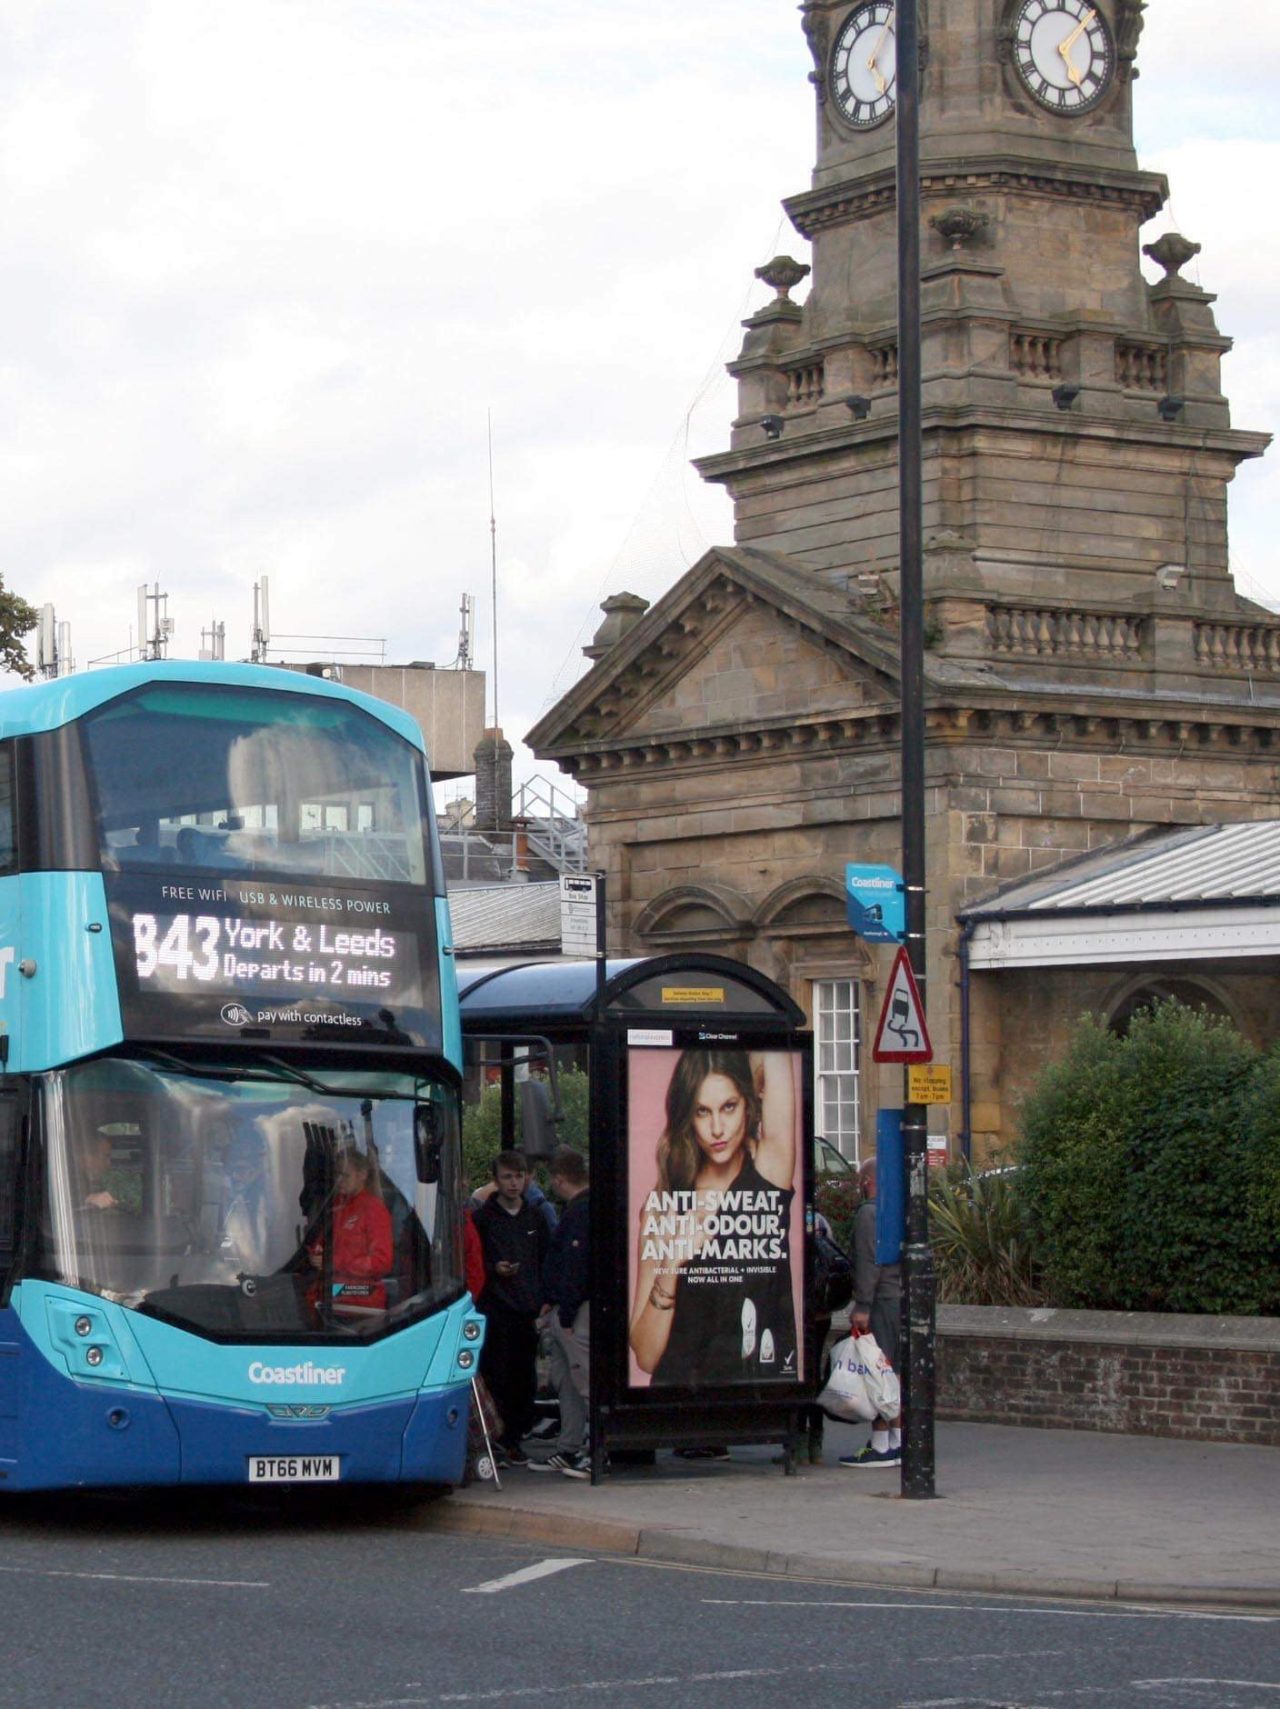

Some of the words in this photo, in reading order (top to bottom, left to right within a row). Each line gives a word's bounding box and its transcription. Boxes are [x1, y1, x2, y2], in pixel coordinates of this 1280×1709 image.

[851, 876, 895, 889] Coastliner
[161, 885, 195, 901] FREE
[198, 887, 228, 902] WIFI
[239, 891, 265, 905] USB
[268, 893, 278, 906] &
[282, 894, 343, 912] WIRELESS
[347, 899, 391, 915] POWER
[224, 917, 285, 951] York
[294, 925, 312, 952] &
[319, 924, 396, 959] Leeds
[223, 953, 304, 982] Departs
[308, 963, 326, 984] in
[331, 960, 342, 984] 2
[347, 965, 391, 988] mins
[257, 1010, 277, 1024] pay
[278, 1009, 302, 1024] with
[305, 1011, 362, 1027] contactless
[645, 1190, 784, 1216] ANTI-SWEAT,
[643, 1214, 786, 1240] ANTI-ODOUR,
[641, 1238, 788, 1261] ANTI-MARKS.
[654, 1267, 670, 1275] NEW
[688, 1266, 740, 1275] ANTIBACTERIAL
[746, 1266, 777, 1274] INVISIBLE
[687, 1276, 707, 1284] NOW
[728, 1275, 744, 1283] ONE
[248, 1360, 347, 1386] Coastliner
[256, 1460, 297, 1478] BT66
[302, 1459, 333, 1477] MVM
